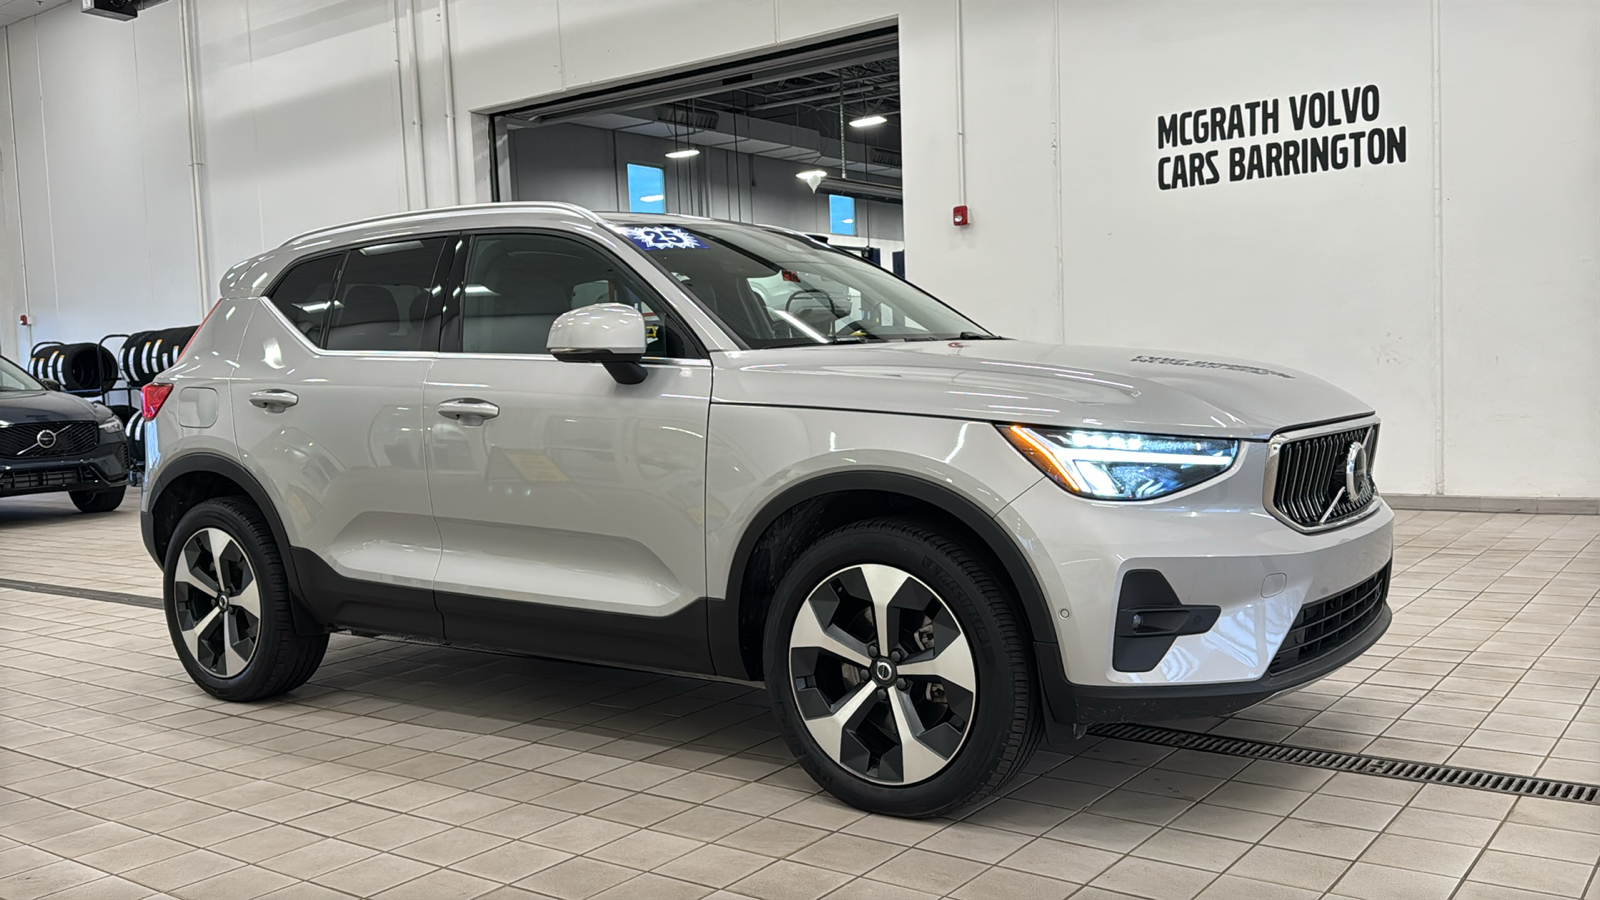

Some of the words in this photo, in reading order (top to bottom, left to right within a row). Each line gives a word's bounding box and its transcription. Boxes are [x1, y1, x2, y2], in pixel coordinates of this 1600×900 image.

[1157, 98, 1279, 149] MCGRATH
[1288, 84, 1380, 131] VOLVO
[1157, 150, 1220, 191] CARS
[1228, 126, 1407, 182] BARRINGTON
[643, 230, 685, 244] 25
